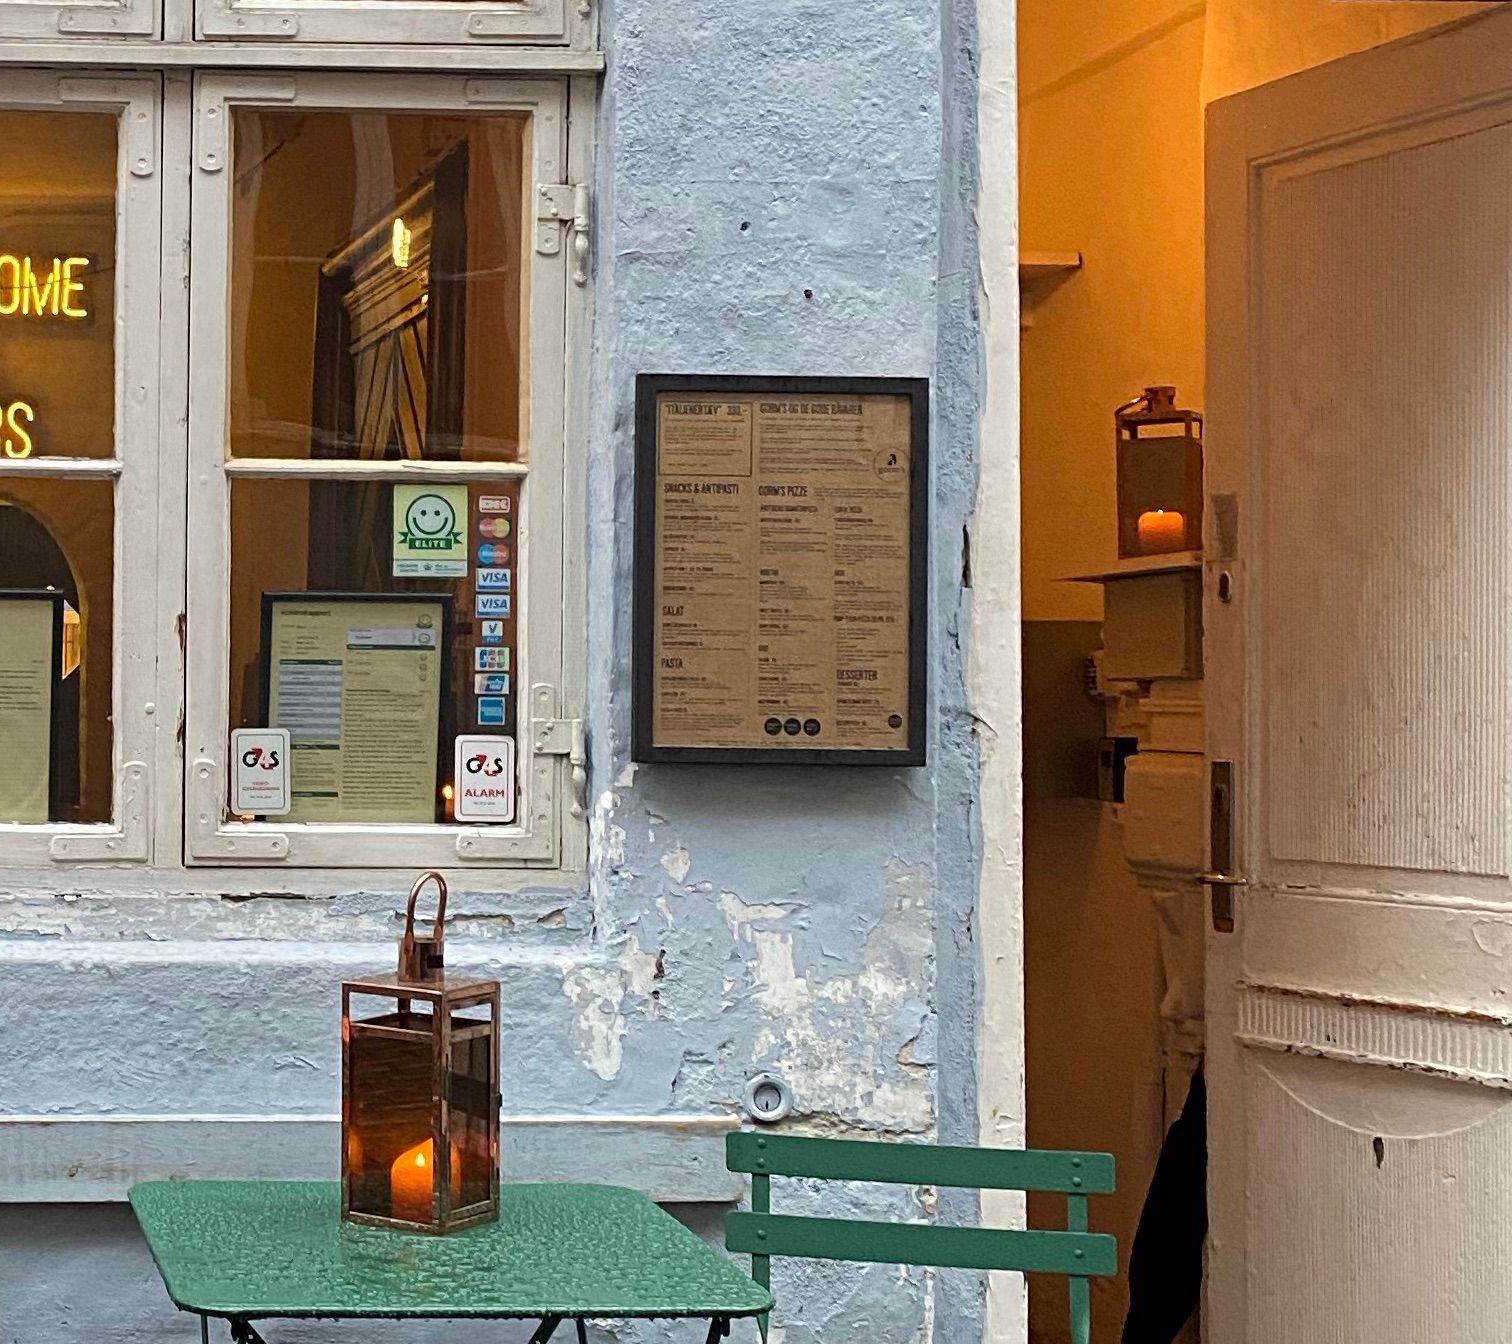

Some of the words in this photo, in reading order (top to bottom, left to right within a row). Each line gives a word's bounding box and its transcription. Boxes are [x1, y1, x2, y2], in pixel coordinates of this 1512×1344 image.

[663, 483, 692, 494] SNACKS
[701, 483, 739, 494] ANTIPASTI
[481, 572, 508, 583] VISA
[481, 598, 508, 609] VISA
[661, 658, 683, 669] PASTA
[836, 669, 878, 681] DESSERTER
[242, 748, 280, 770] G4S
[466, 754, 504, 776] G4S
[464, 788, 505, 797] ALARM
